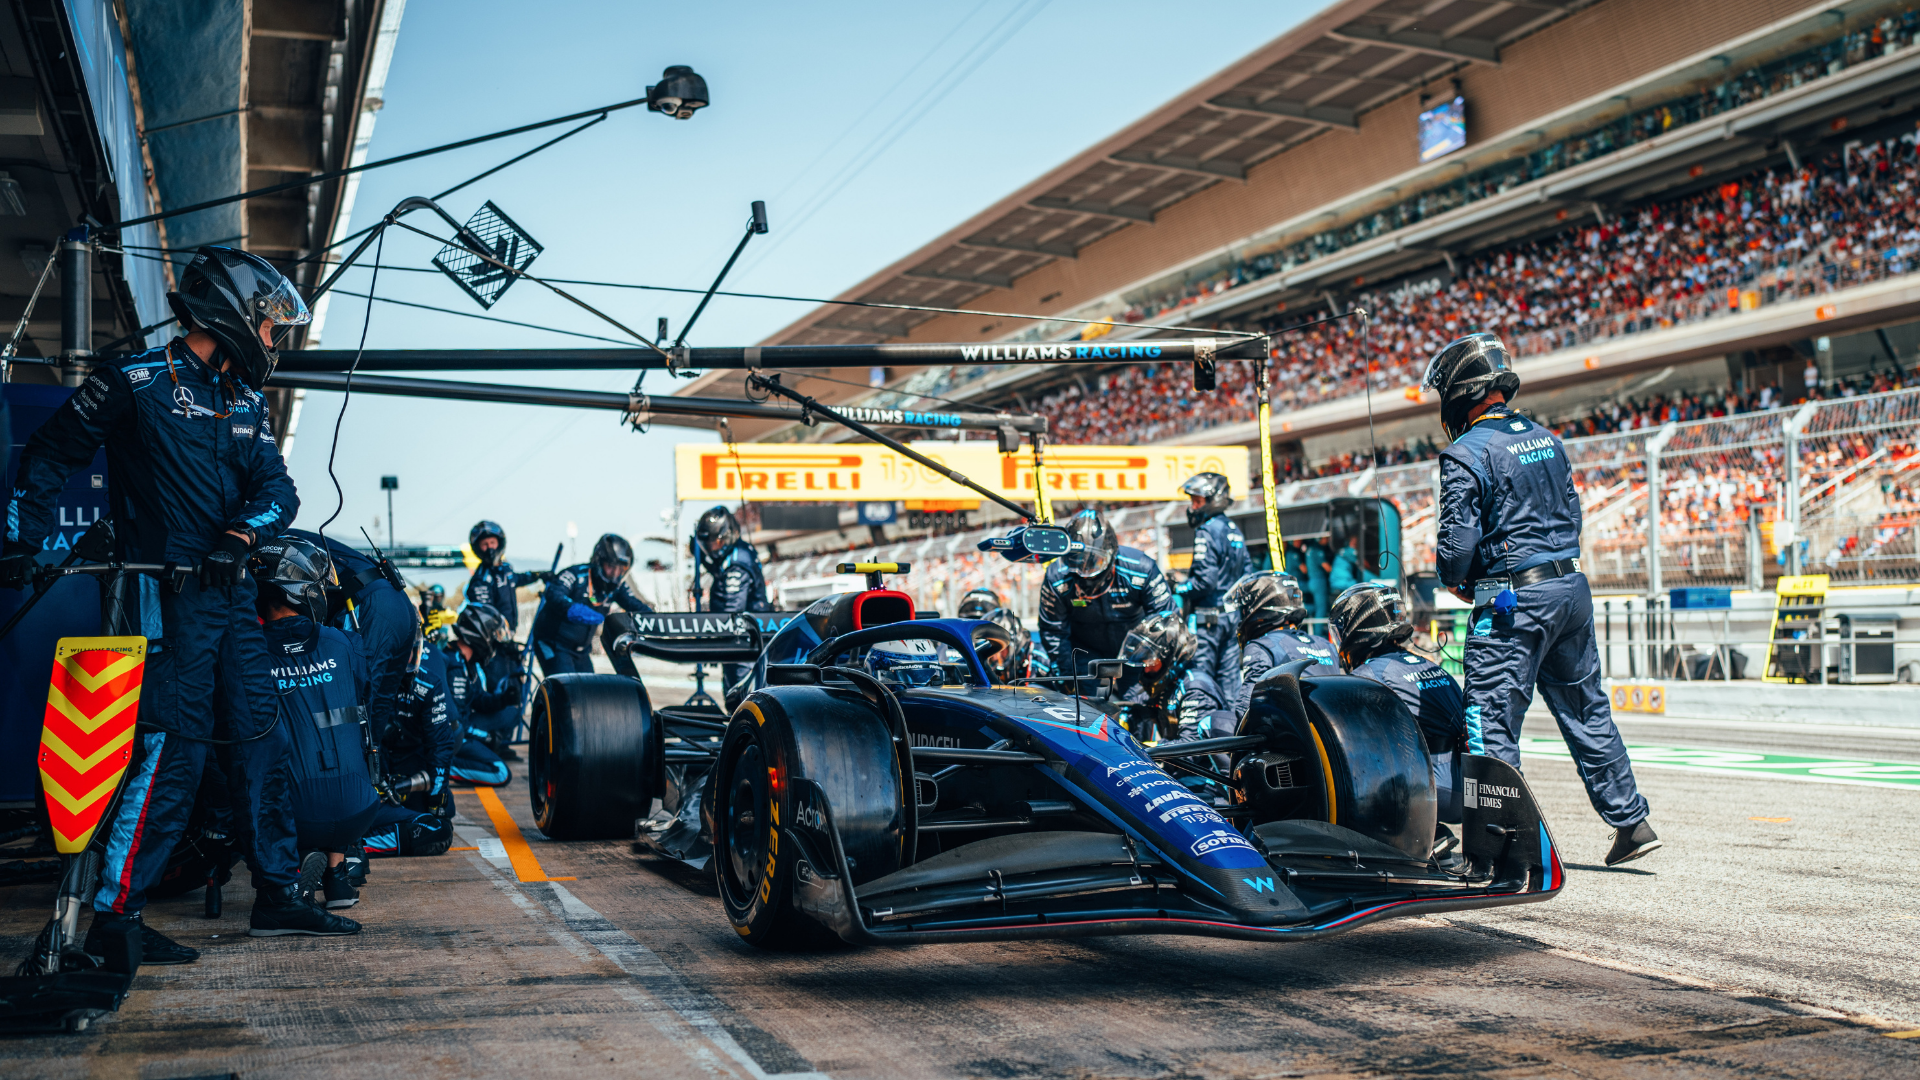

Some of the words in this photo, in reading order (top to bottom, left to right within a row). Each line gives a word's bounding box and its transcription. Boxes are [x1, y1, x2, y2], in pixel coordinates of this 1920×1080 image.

[960, 344, 1072, 361] WILLIAMS
[1075, 345, 1162, 359] RACING
[129, 370, 150, 381] OMP
[904, 410, 962, 427] RACING
[1506, 436, 1555, 455] WILLIAMS
[1518, 448, 1555, 465] RACING
[701, 454, 863, 490] PIRELLI
[1002, 456, 1149, 490] PIRELLI
[635, 614, 747, 633] WILLIAMS
[270, 658, 337, 678] WILLIAMS
[1402, 668, 1448, 682] WILLIAMS
[278, 671, 333, 690] RACING
[1416, 677, 1450, 691] RACING
[1043, 707, 1085, 722] 6
[1464, 781, 1477, 798] FT
[1478, 783, 1521, 799] FINANCIAL
[1479, 796, 1502, 809] TIMES
[760, 798, 780, 905] ZERO
[1242, 876, 1275, 893] W
